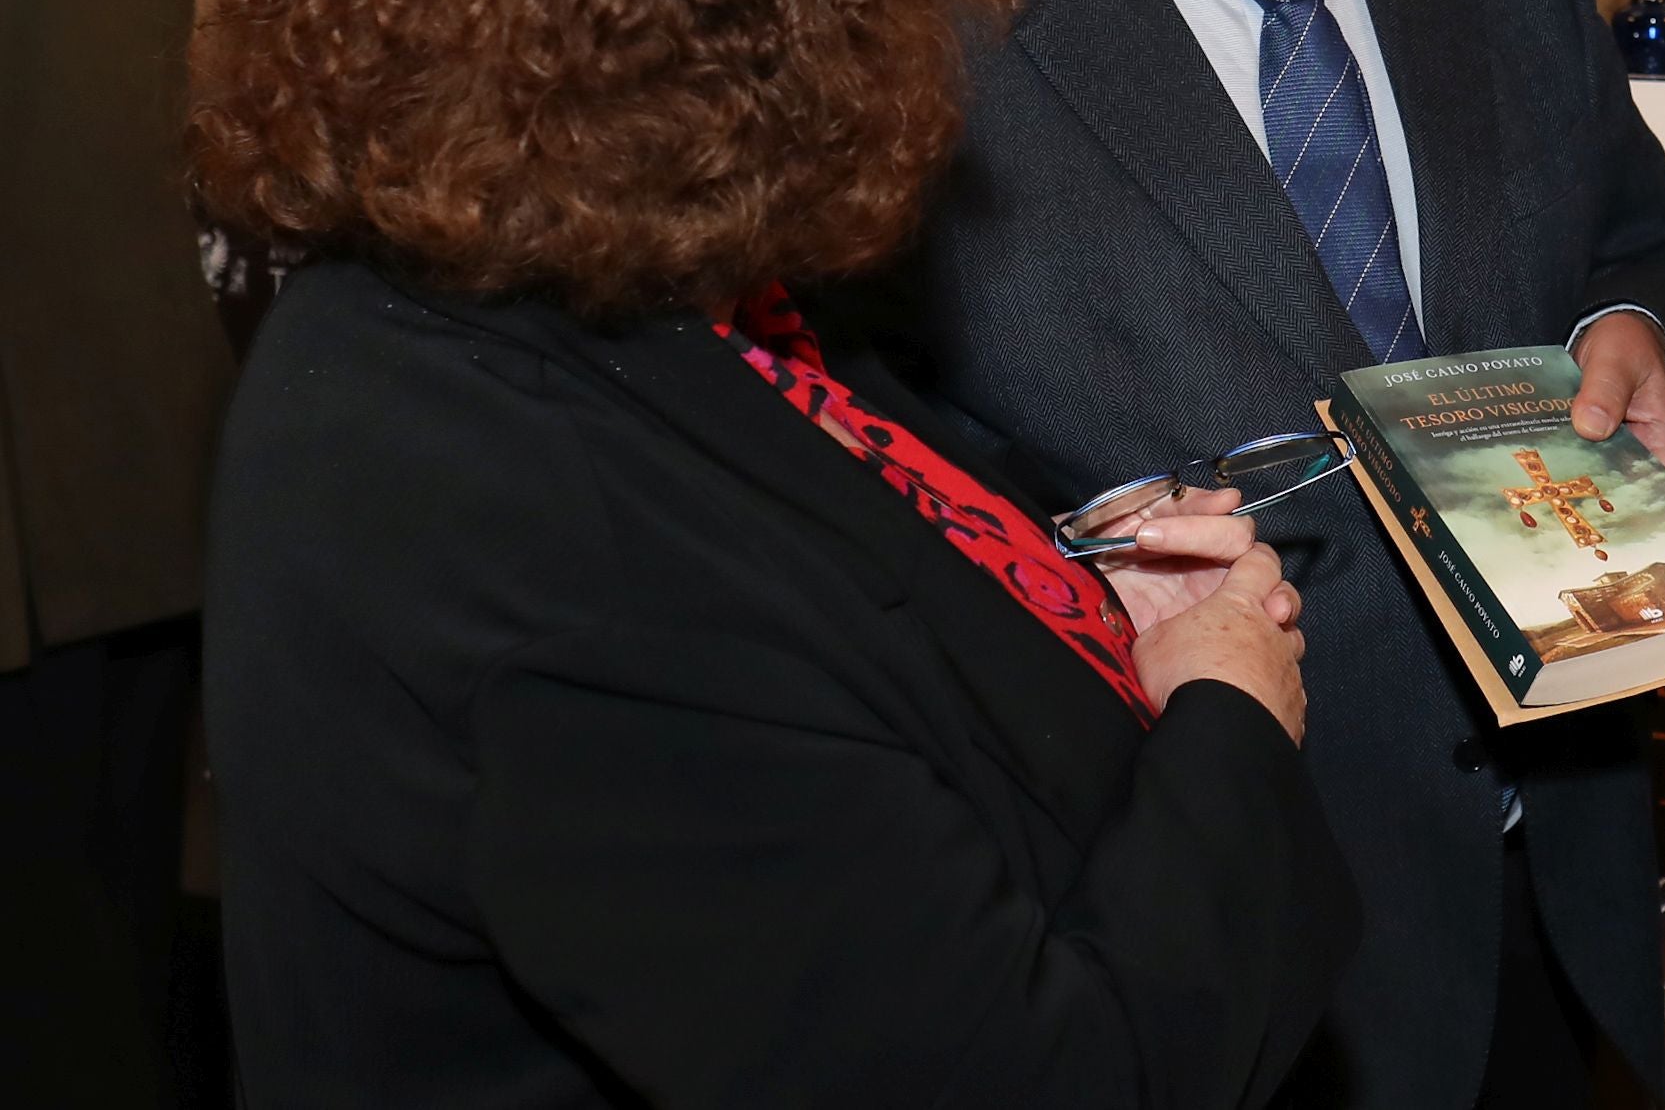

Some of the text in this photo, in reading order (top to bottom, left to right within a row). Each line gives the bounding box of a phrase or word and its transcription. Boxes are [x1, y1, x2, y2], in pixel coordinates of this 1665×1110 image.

[1383, 356, 1543, 388] JOSÉ CALVO POYATO
[1427, 381, 1535, 407] EL ÚLTIMO
[1400, 407, 1484, 430] TESORO
[1368, 450, 1401, 502] VISIGODO
[1438, 550, 1500, 639] JOSÉ CALVO POYATO
